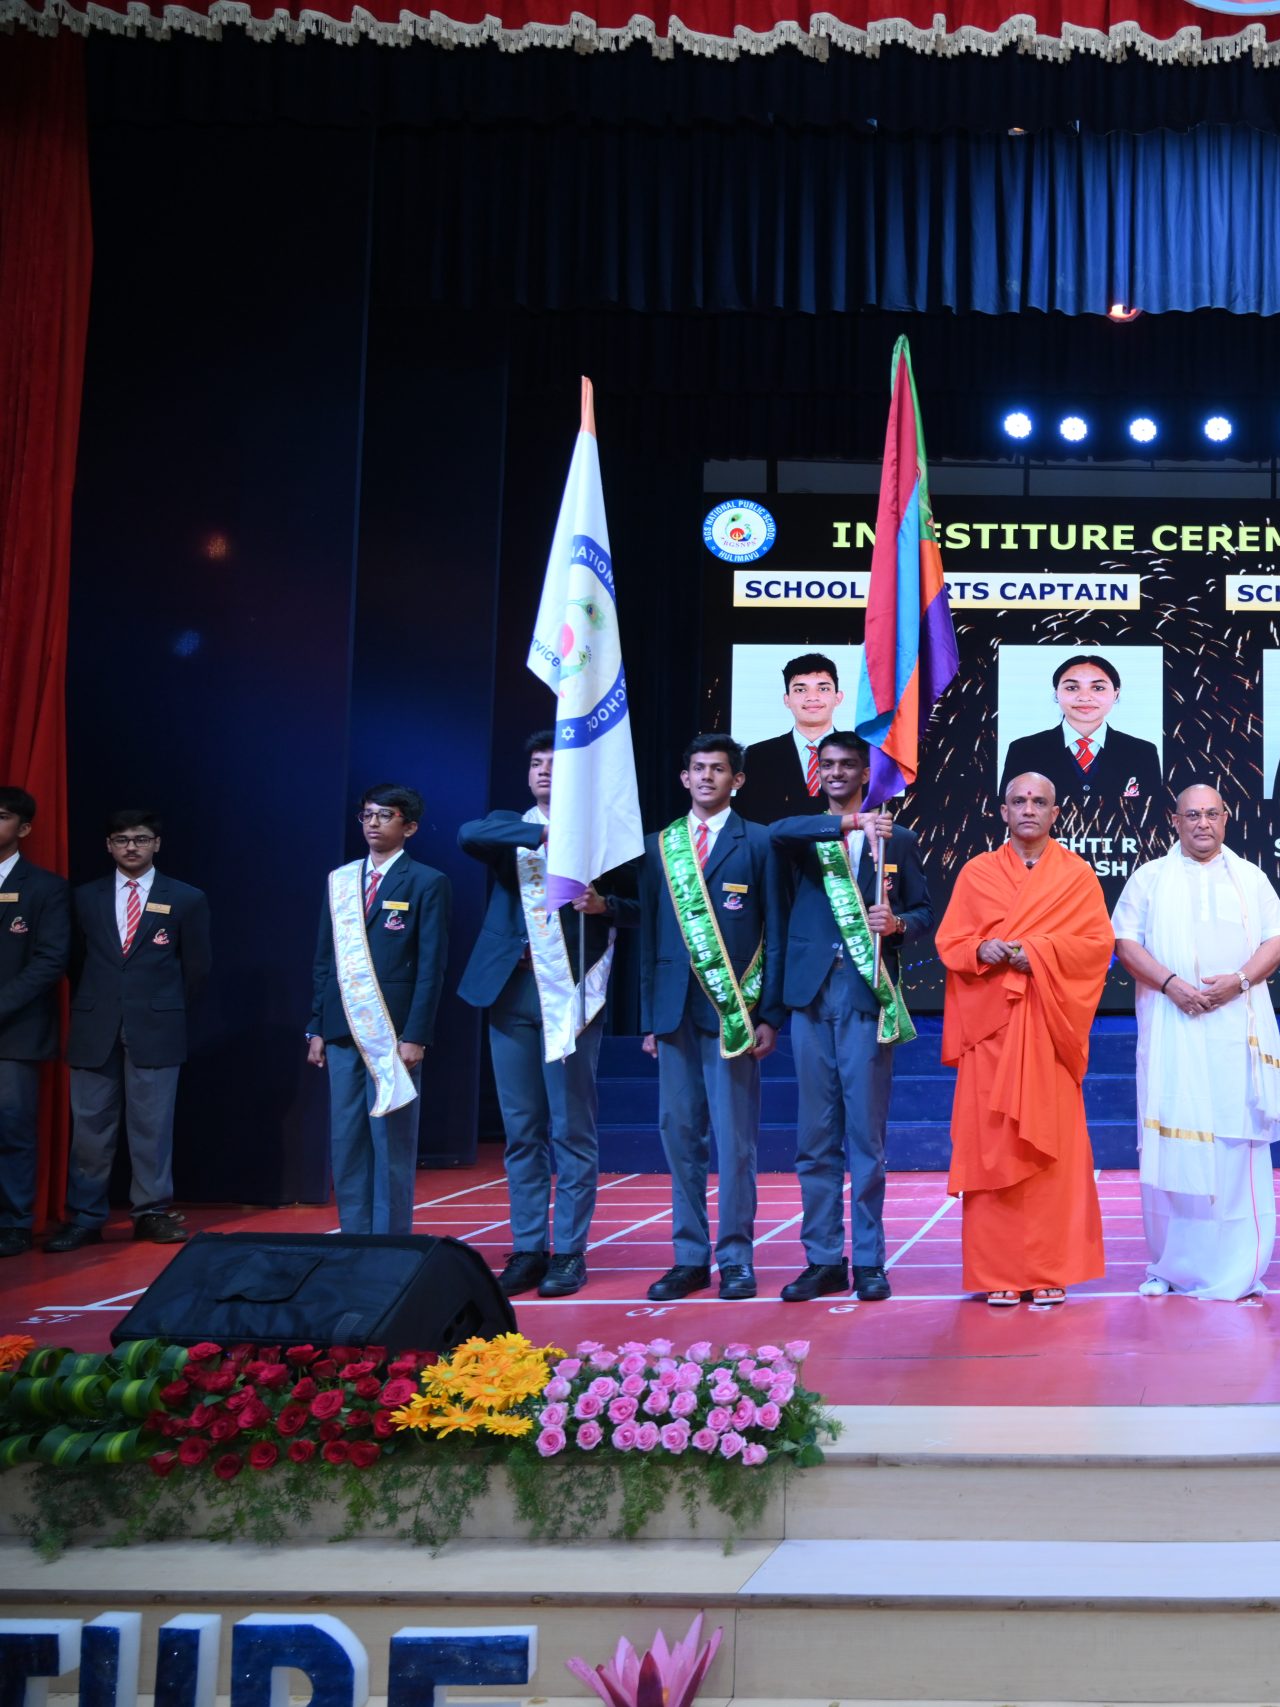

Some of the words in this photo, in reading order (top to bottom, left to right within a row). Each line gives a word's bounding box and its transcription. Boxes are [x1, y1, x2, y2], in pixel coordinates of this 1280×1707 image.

[707, 501, 737, 526] NATIONAL
[738, 500, 766, 515] PUBLIC
[762, 514, 776, 541] SCHOOL
[832, 522, 1135, 551] INSTITURE
[718, 551, 760, 562] HULIMAVU
[745, 580, 865, 599] SCHOOL
[999, 582, 1128, 601] CAPTAIN
[1055, 838, 1113, 854] SHTI
[1121, 838, 1138, 854] R
[704, 968, 728, 1003] BOYS
